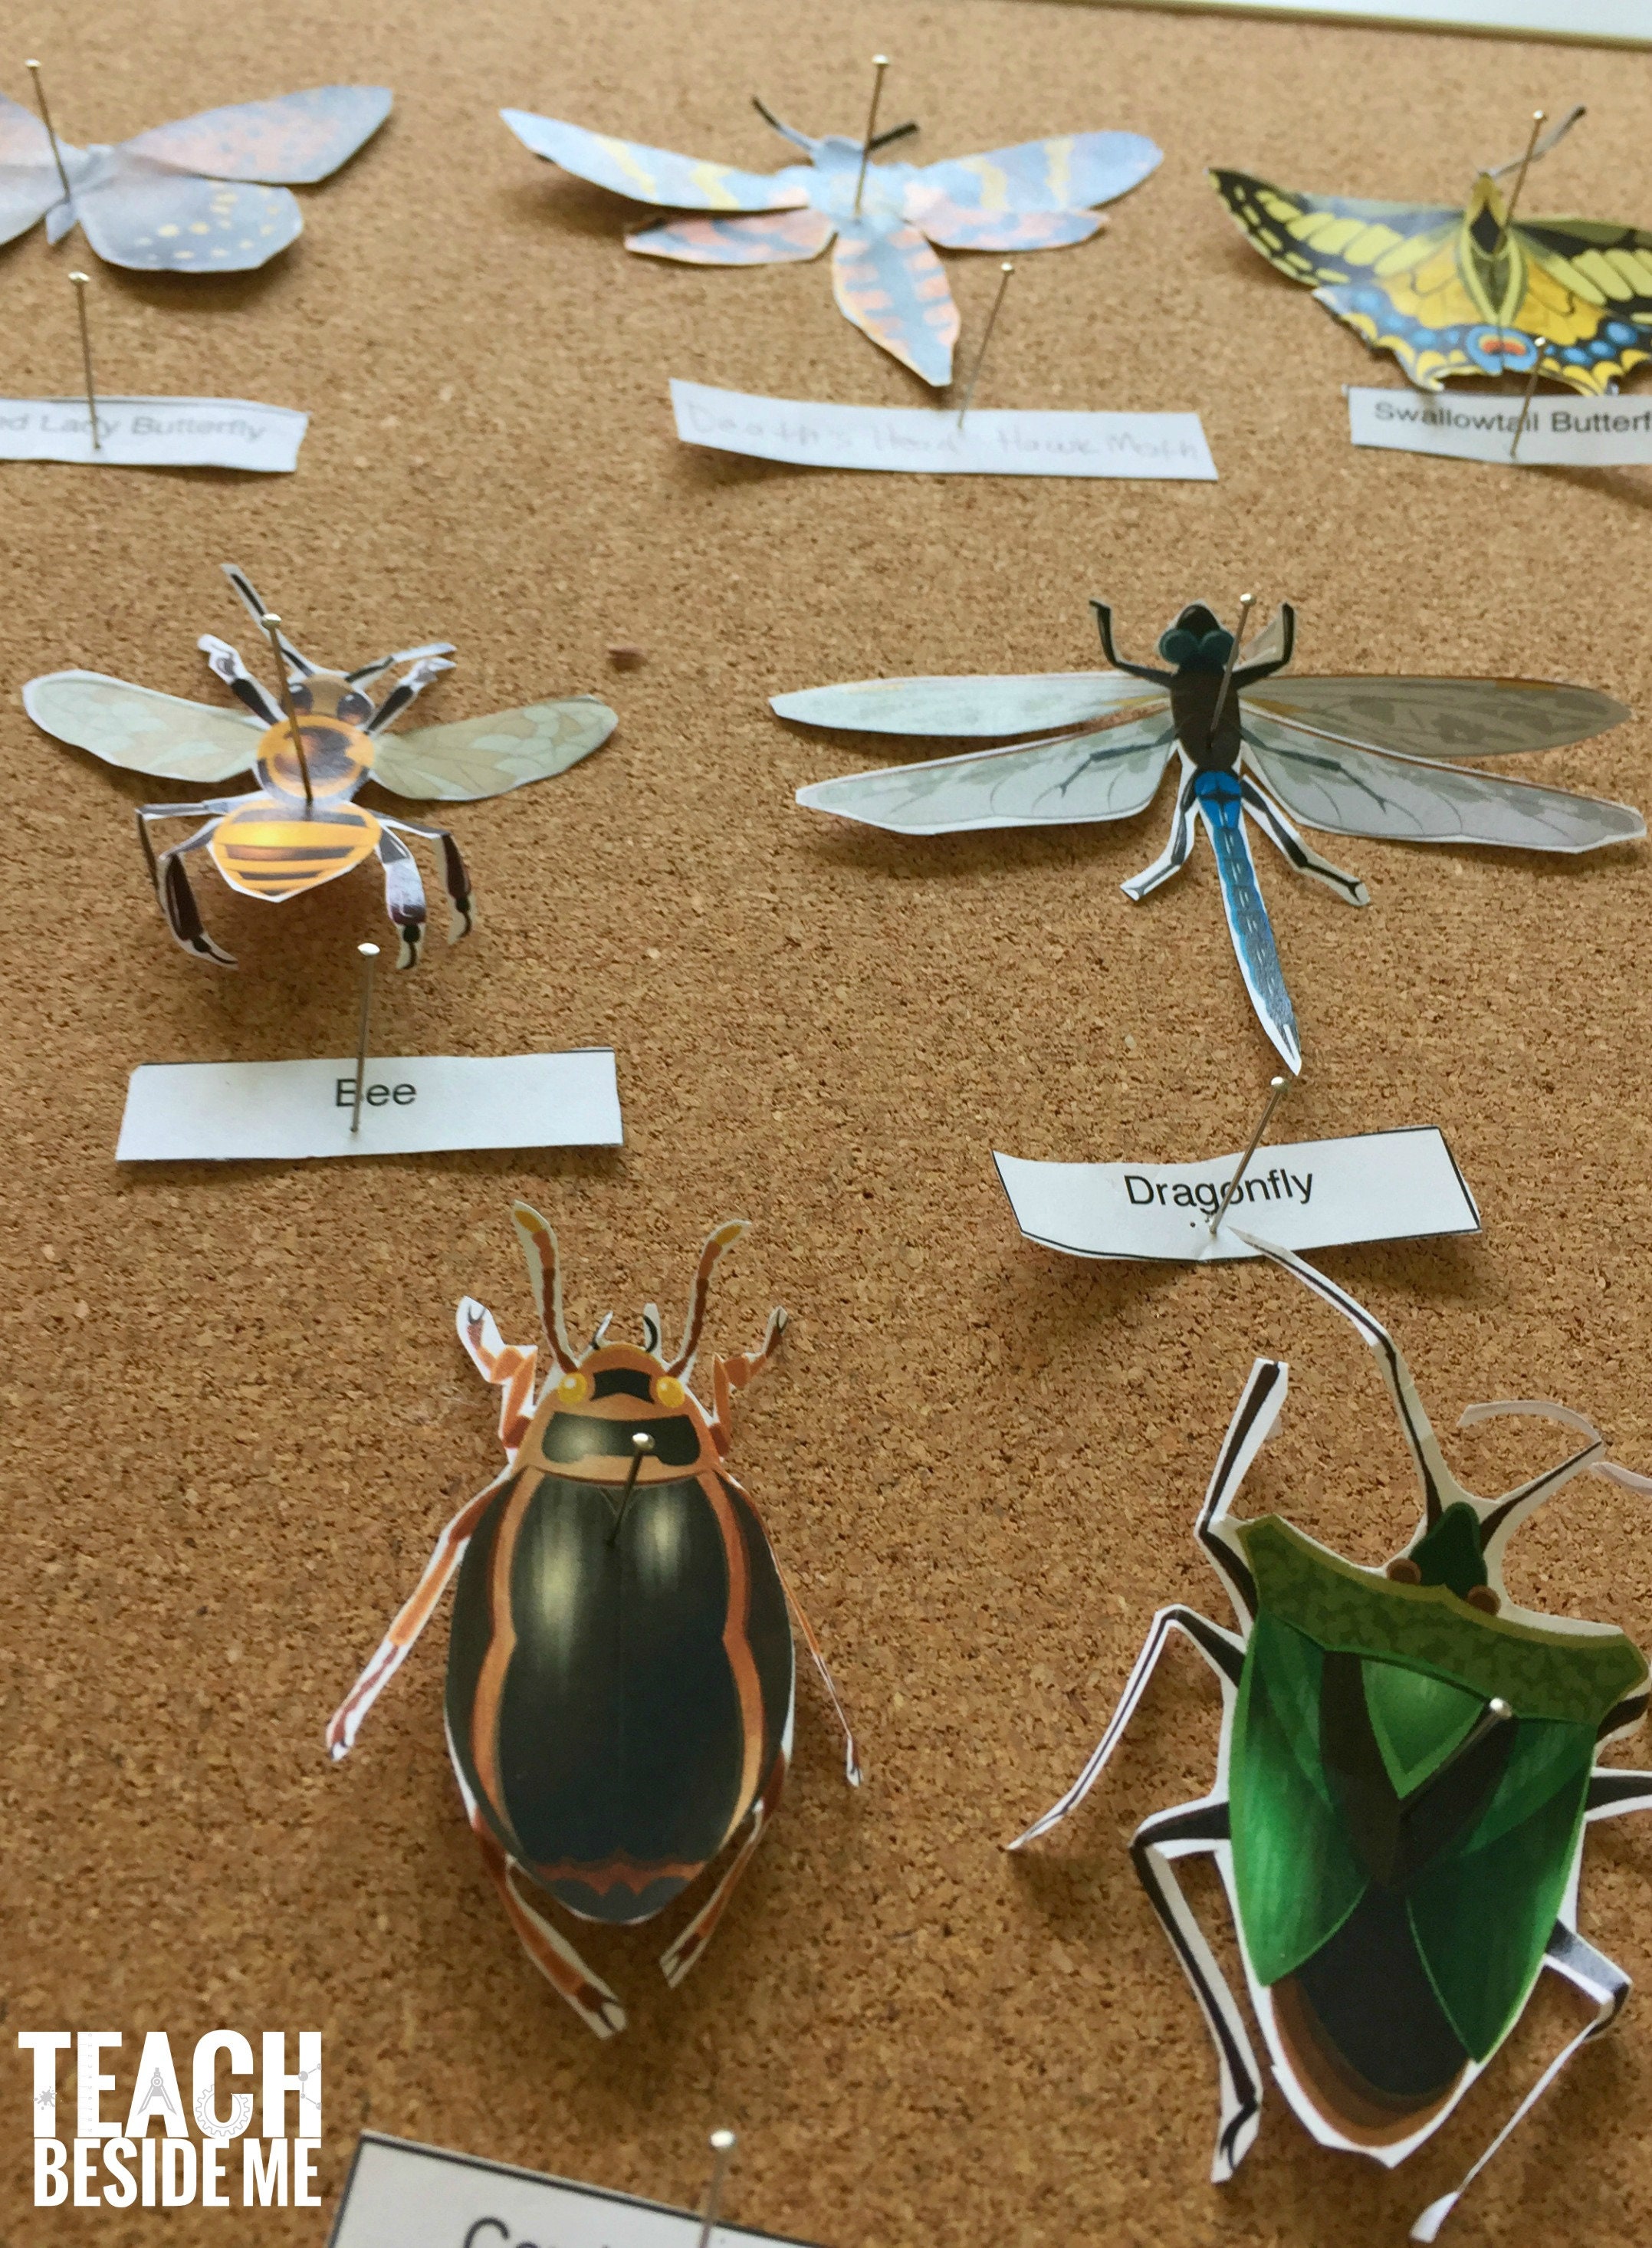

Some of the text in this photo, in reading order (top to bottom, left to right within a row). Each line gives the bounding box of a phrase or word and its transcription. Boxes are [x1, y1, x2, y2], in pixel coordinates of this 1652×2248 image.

[132, 416, 265, 442] Butterfly
[1374, 401, 1539, 433] Swallowtail
[1123, 1168, 1313, 1216] Dragonfly
